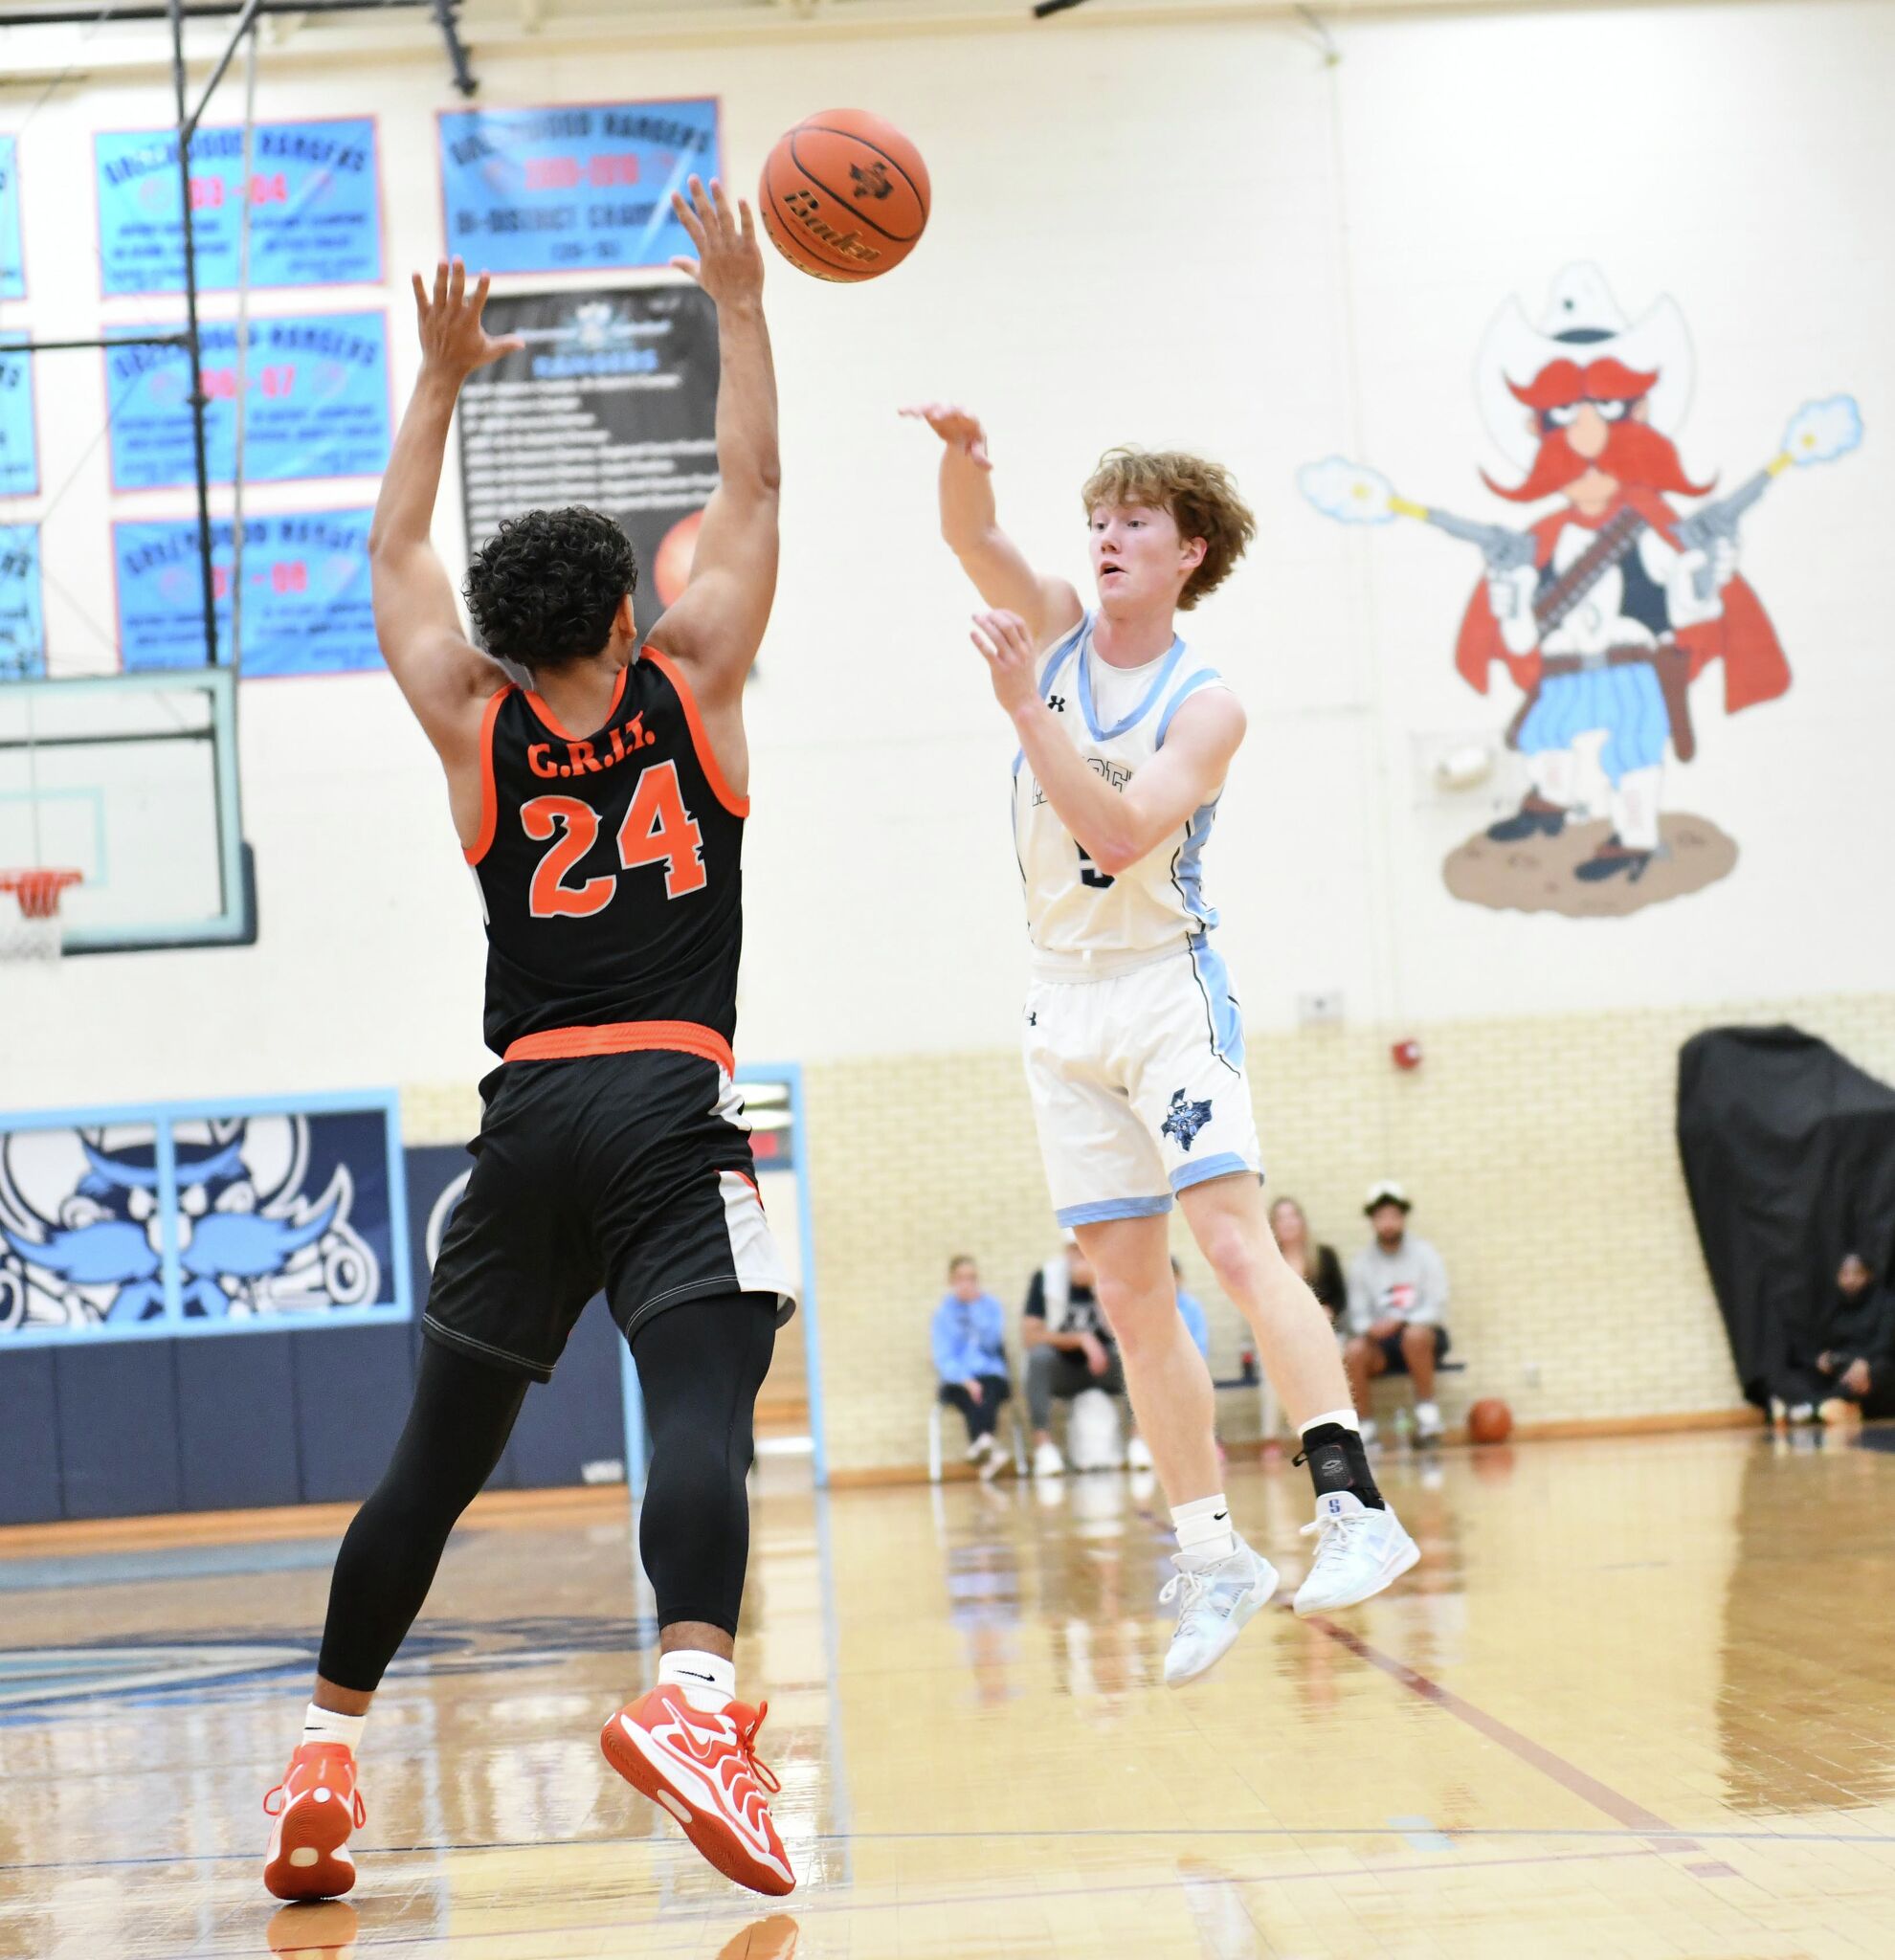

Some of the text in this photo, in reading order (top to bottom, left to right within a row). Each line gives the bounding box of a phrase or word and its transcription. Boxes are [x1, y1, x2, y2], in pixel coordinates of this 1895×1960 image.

[260, 132, 367, 173] RANGERS
[527, 710, 656, 778] G.R.I.T.
[520, 758, 707, 919] 24
